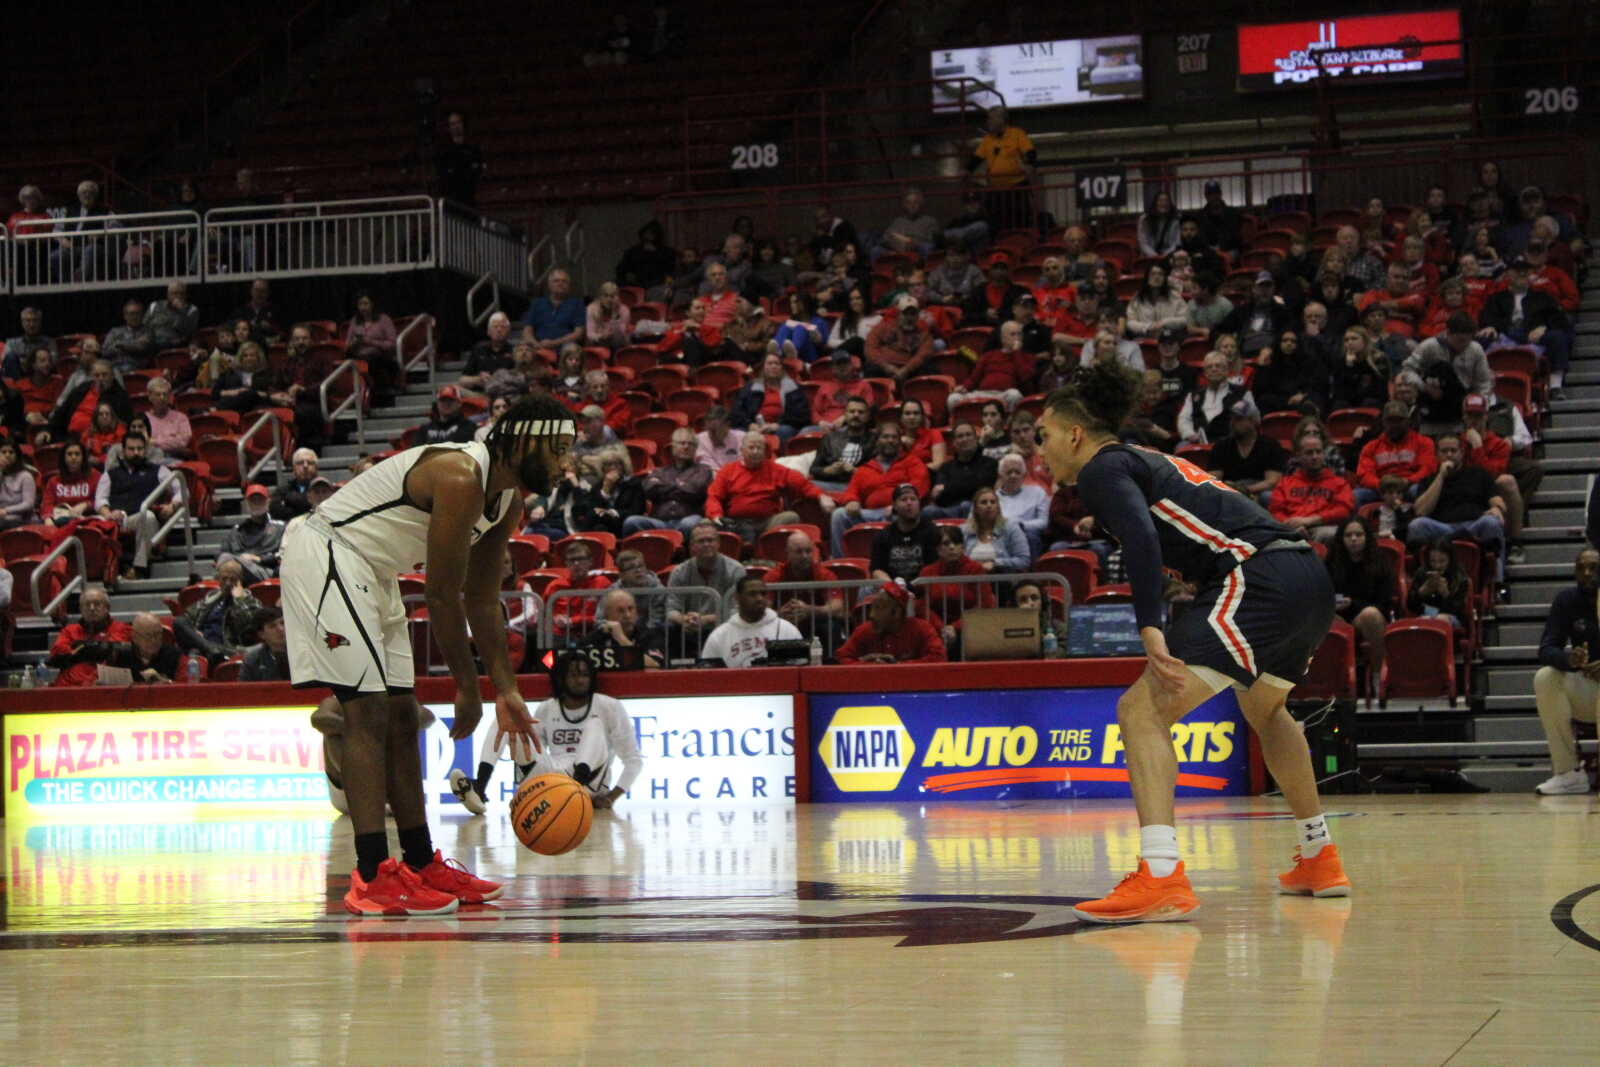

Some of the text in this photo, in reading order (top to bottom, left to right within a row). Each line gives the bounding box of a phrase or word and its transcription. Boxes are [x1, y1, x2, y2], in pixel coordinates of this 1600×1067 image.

[1177, 33, 1211, 52] 207
[1525, 87, 1579, 114] 206
[731, 144, 779, 170] 208
[1079, 176, 1122, 200] 107
[56, 482, 90, 498] SEMO
[730, 637, 769, 659] SEM
[630, 711, 796, 758] Francis
[921, 725, 1039, 768] AUTO
[1048, 729, 1092, 745] TIRE
[1101, 721, 1236, 764] PRTS
[10, 732, 120, 792] PLAZA
[132, 730, 208, 762] TIRE
[835, 728, 900, 770] NAPA
[1047, 745, 1093, 762] AND
[41, 776, 327, 803] THE QUICK CHANGE ARTIS
[520, 799, 552, 834] NCAA
